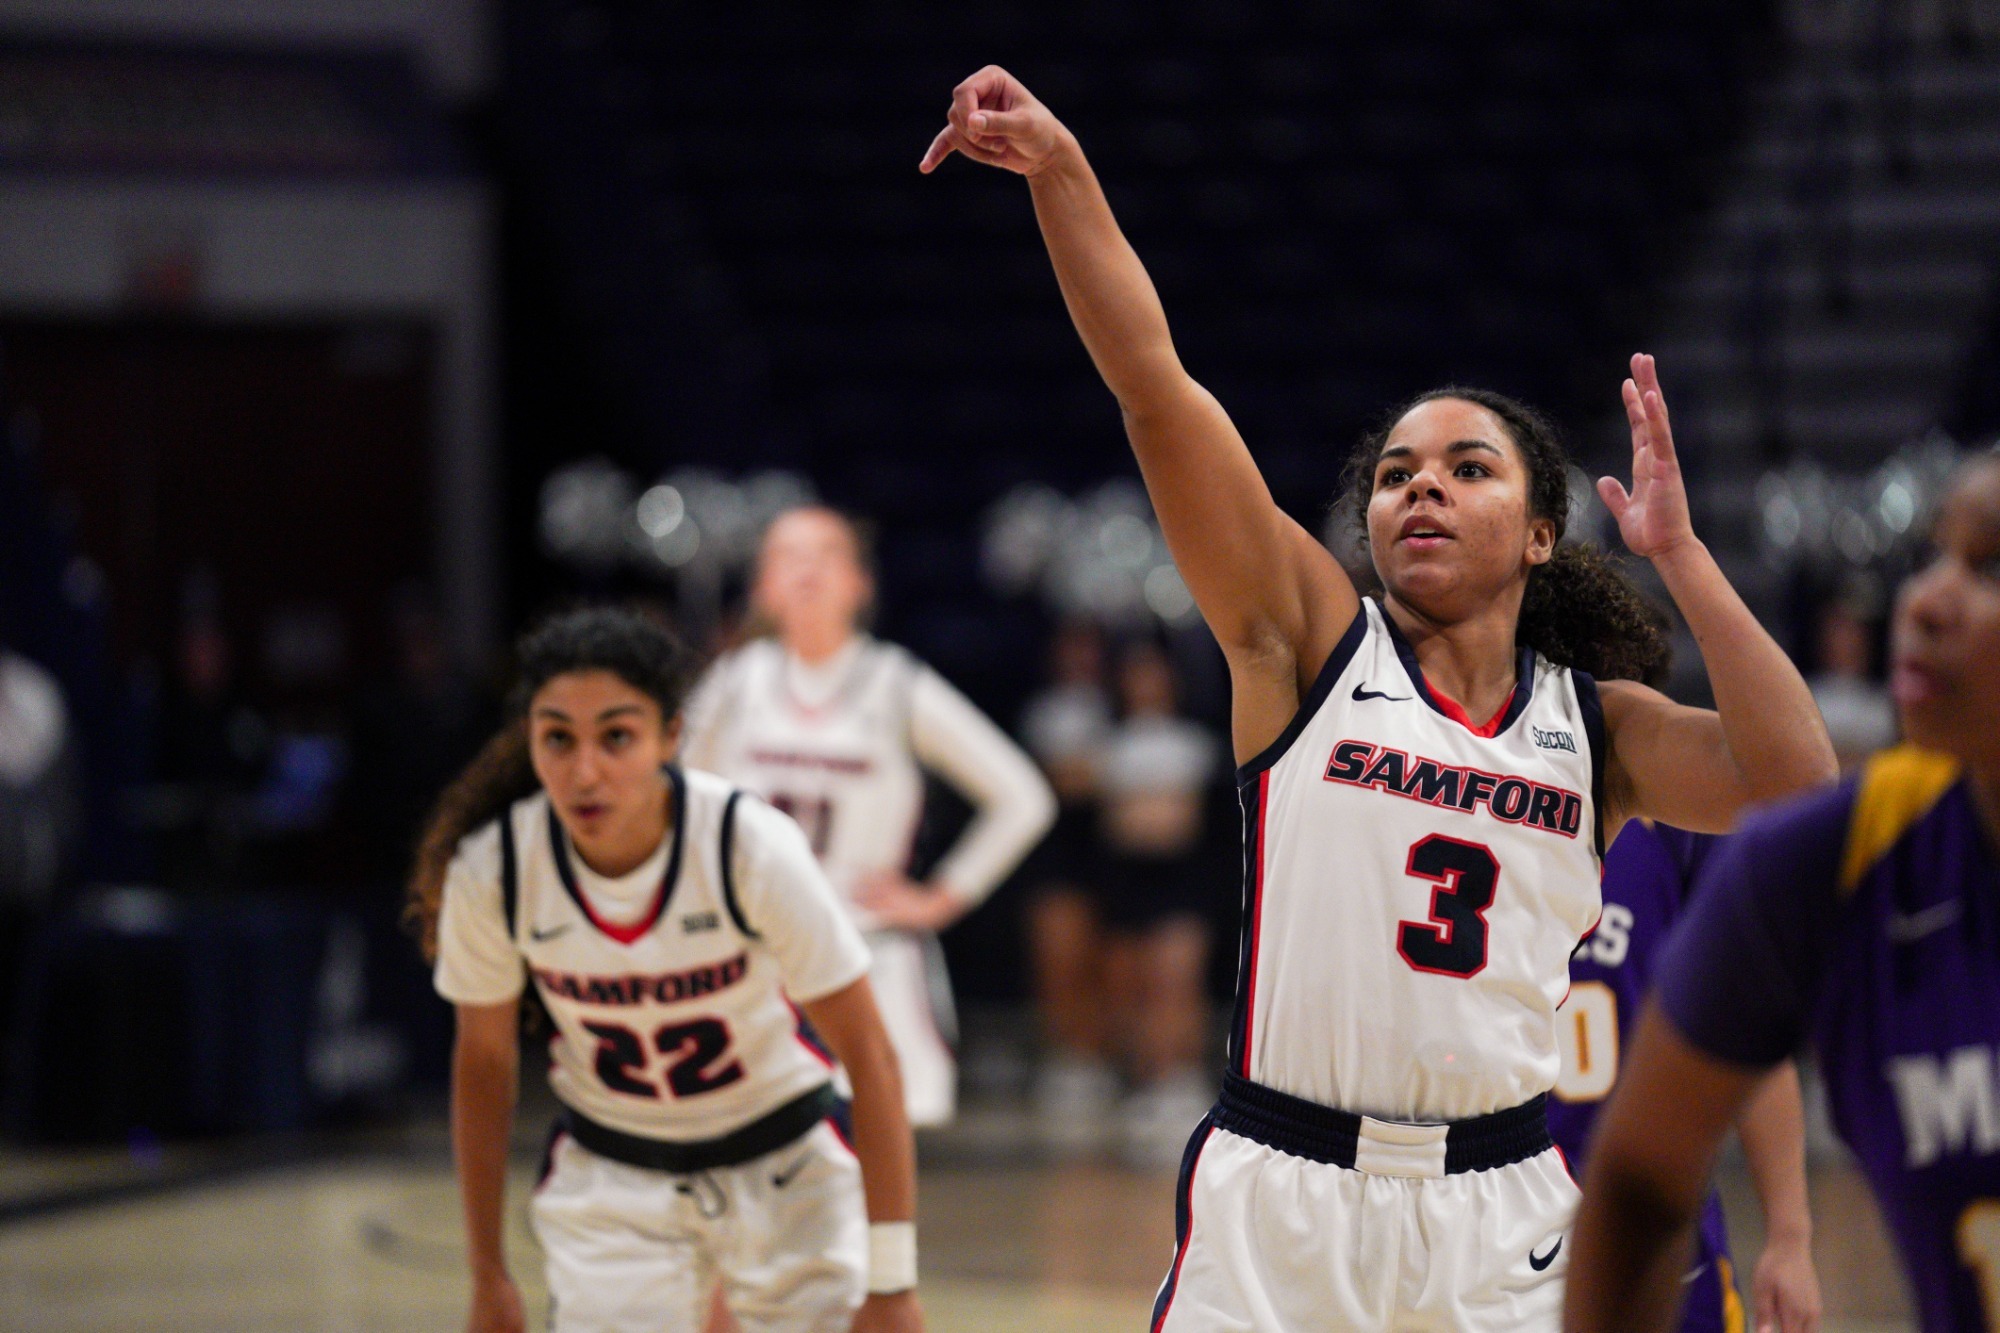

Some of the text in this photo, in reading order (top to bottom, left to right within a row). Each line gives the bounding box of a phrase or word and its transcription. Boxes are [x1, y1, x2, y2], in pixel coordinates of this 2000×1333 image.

[1532, 725, 1577, 754] SOCON
[1323, 739, 1583, 839] SAMFORD
[1396, 833, 1501, 980] 3
[1573, 902, 1635, 968] S
[579, 1012, 745, 1099] 22
[1882, 1043, 2000, 1168] M
